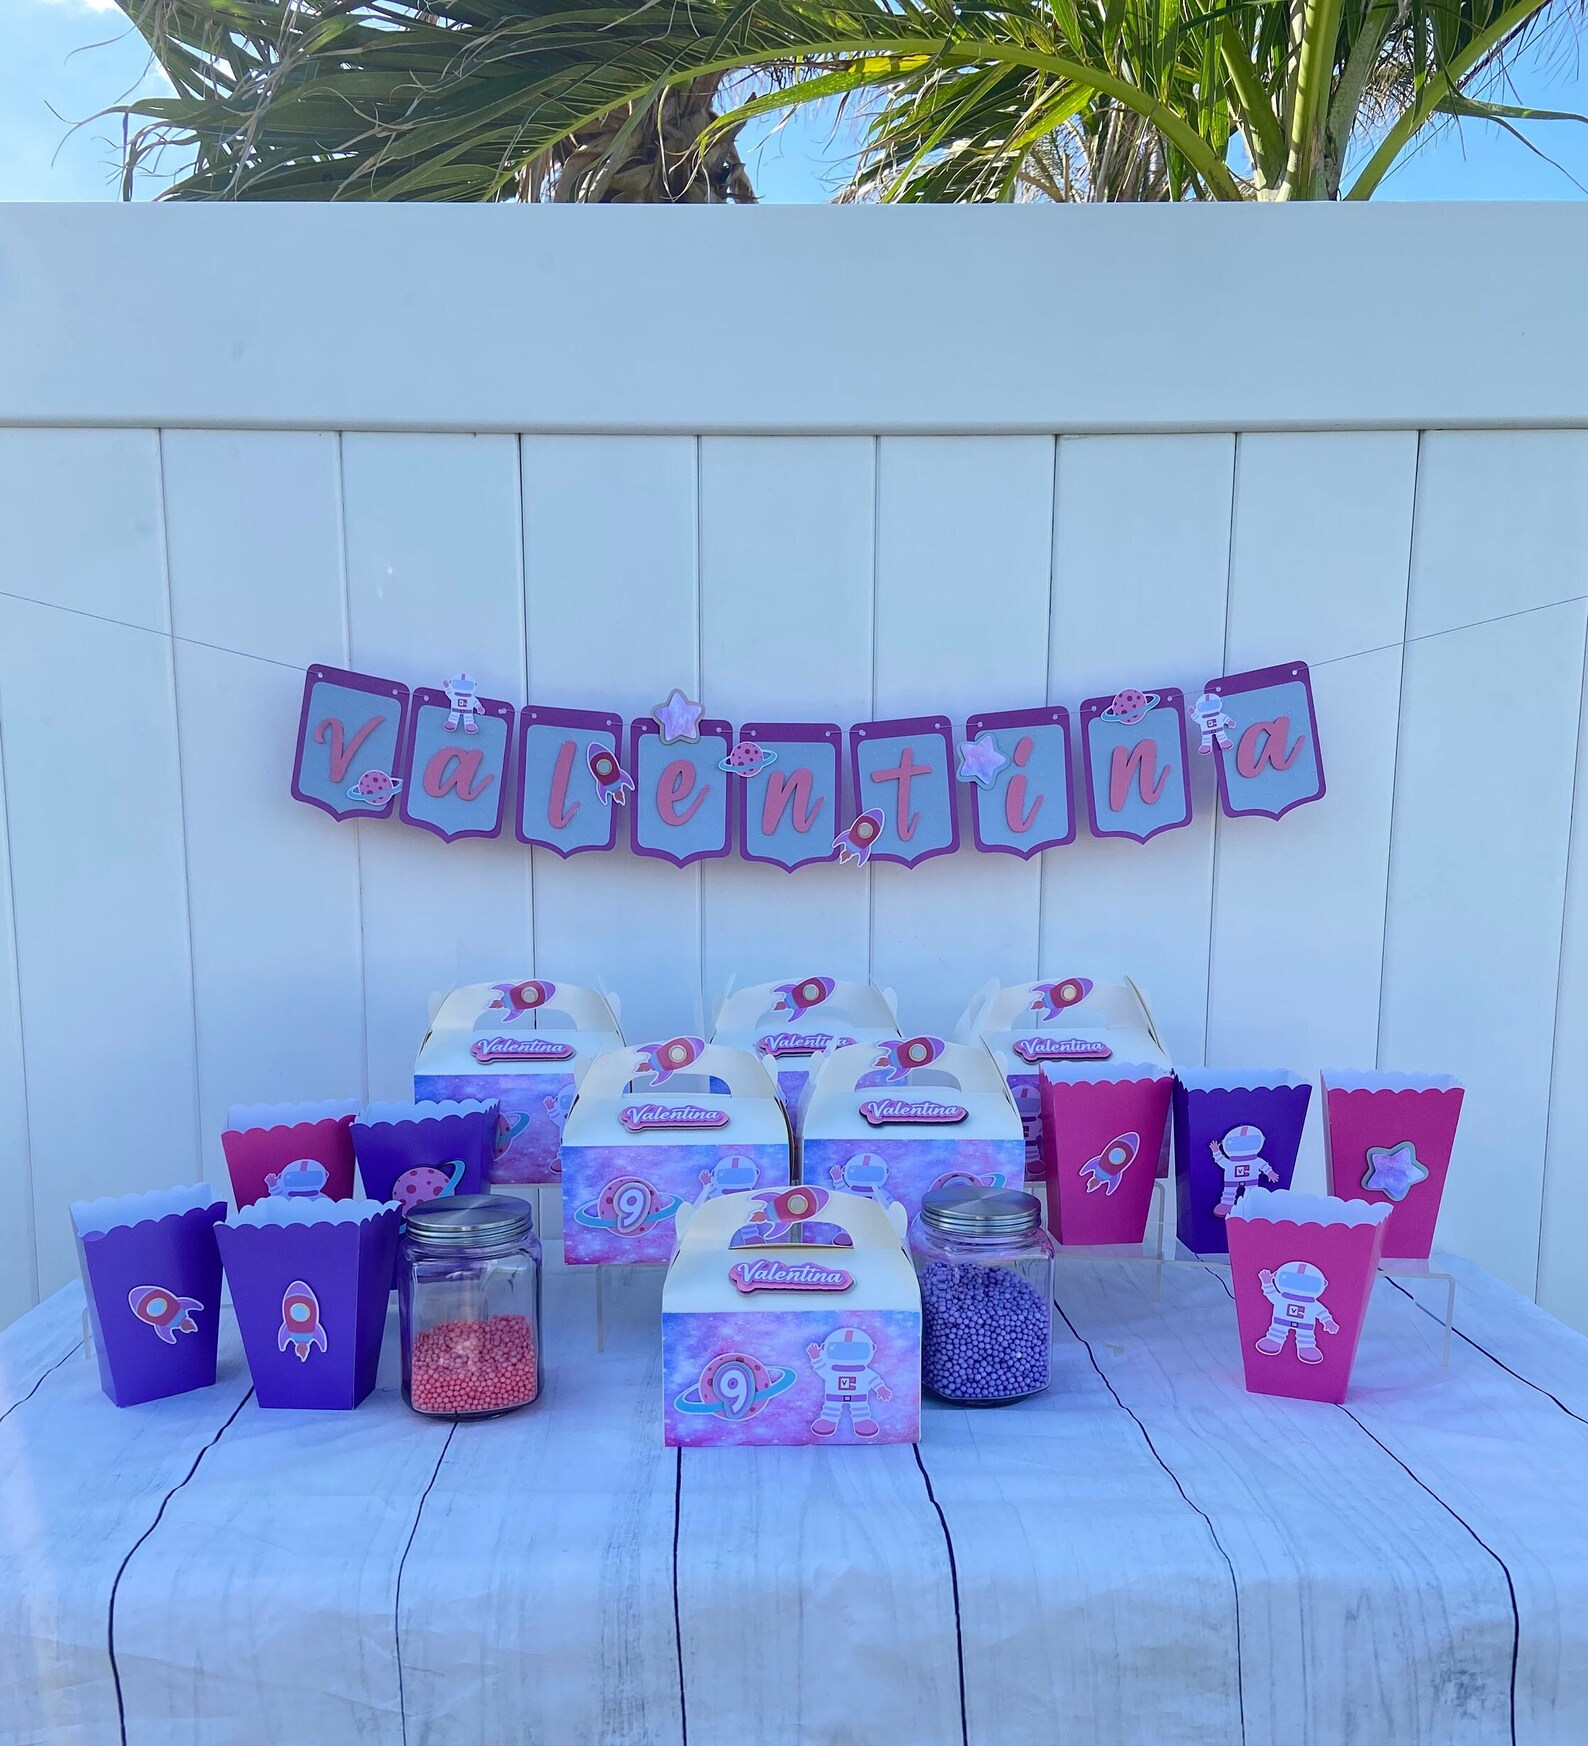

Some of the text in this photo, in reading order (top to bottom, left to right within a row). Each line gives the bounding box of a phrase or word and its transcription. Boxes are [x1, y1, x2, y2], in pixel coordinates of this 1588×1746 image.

[314, 714, 1307, 842] Valentina
[477, 1037, 565, 1054] Valentina
[1021, 1039, 1103, 1054] Valentina
[626, 1105, 718, 1124] Valentina
[868, 1100, 959, 1118] Valentina
[619, 1187, 648, 1227] 9
[737, 1261, 843, 1284] Valentina
[719, 1369, 747, 1413] 9
